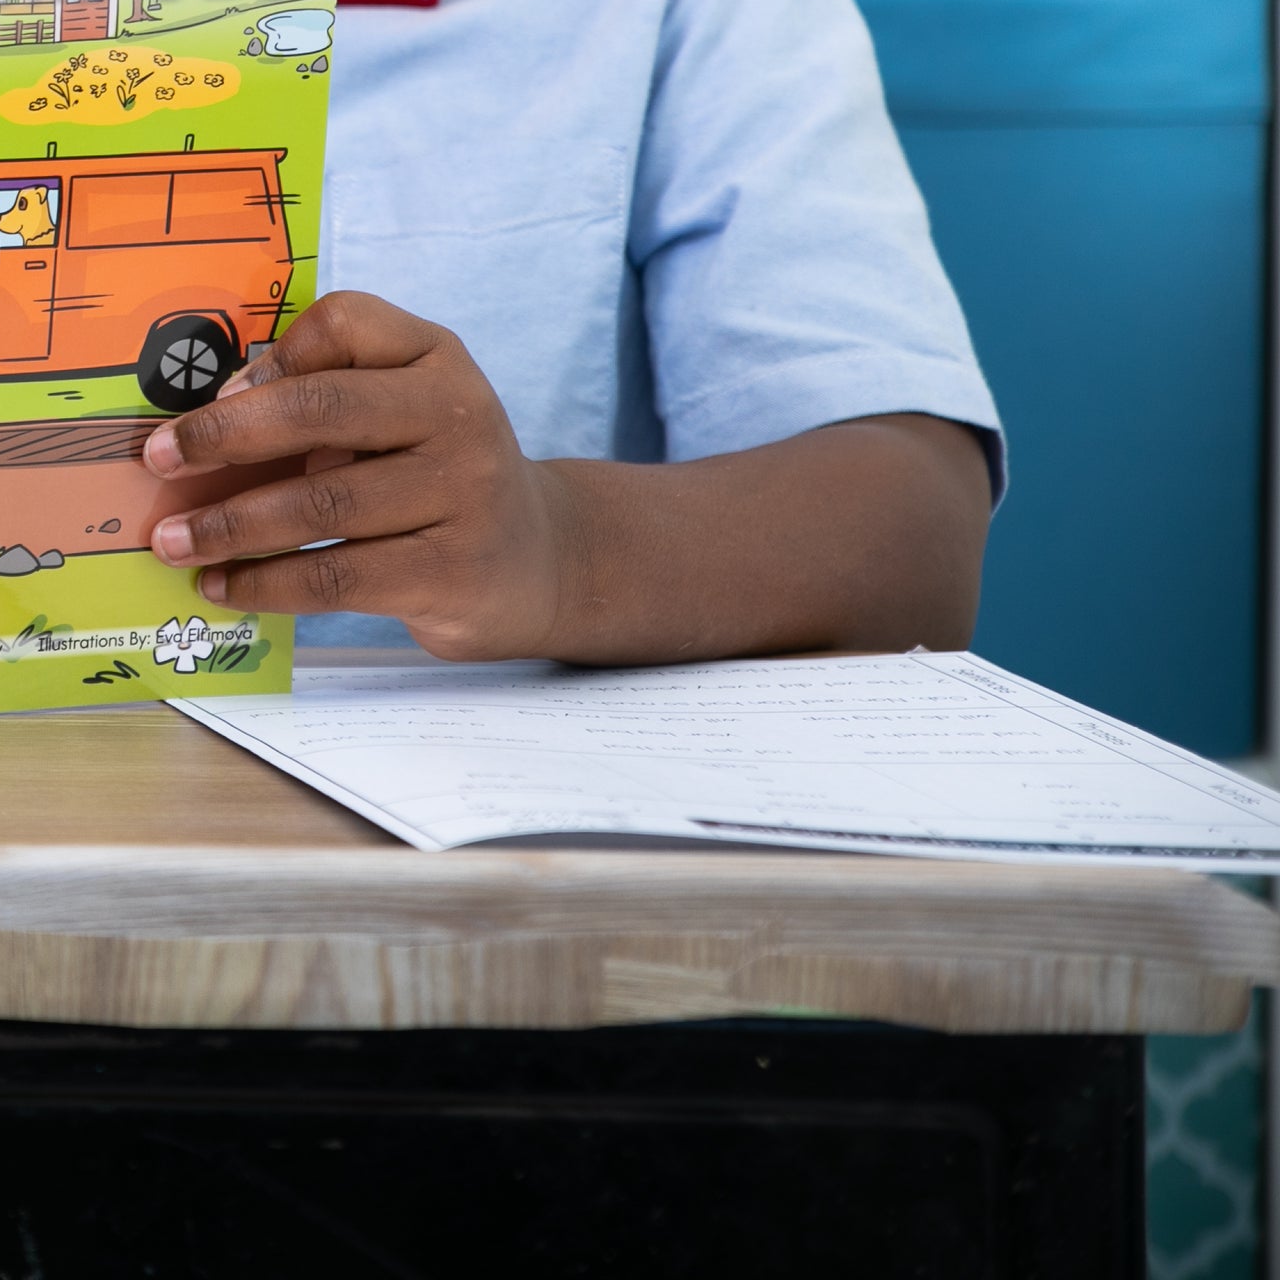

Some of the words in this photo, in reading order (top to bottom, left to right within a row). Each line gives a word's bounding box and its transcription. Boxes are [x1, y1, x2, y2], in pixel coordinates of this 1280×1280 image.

[38, 633, 125, 653] Illustrations
[128, 631, 152, 652] By:
[155, 628, 183, 645] Eva
[187, 625, 254, 643] Elfimova
